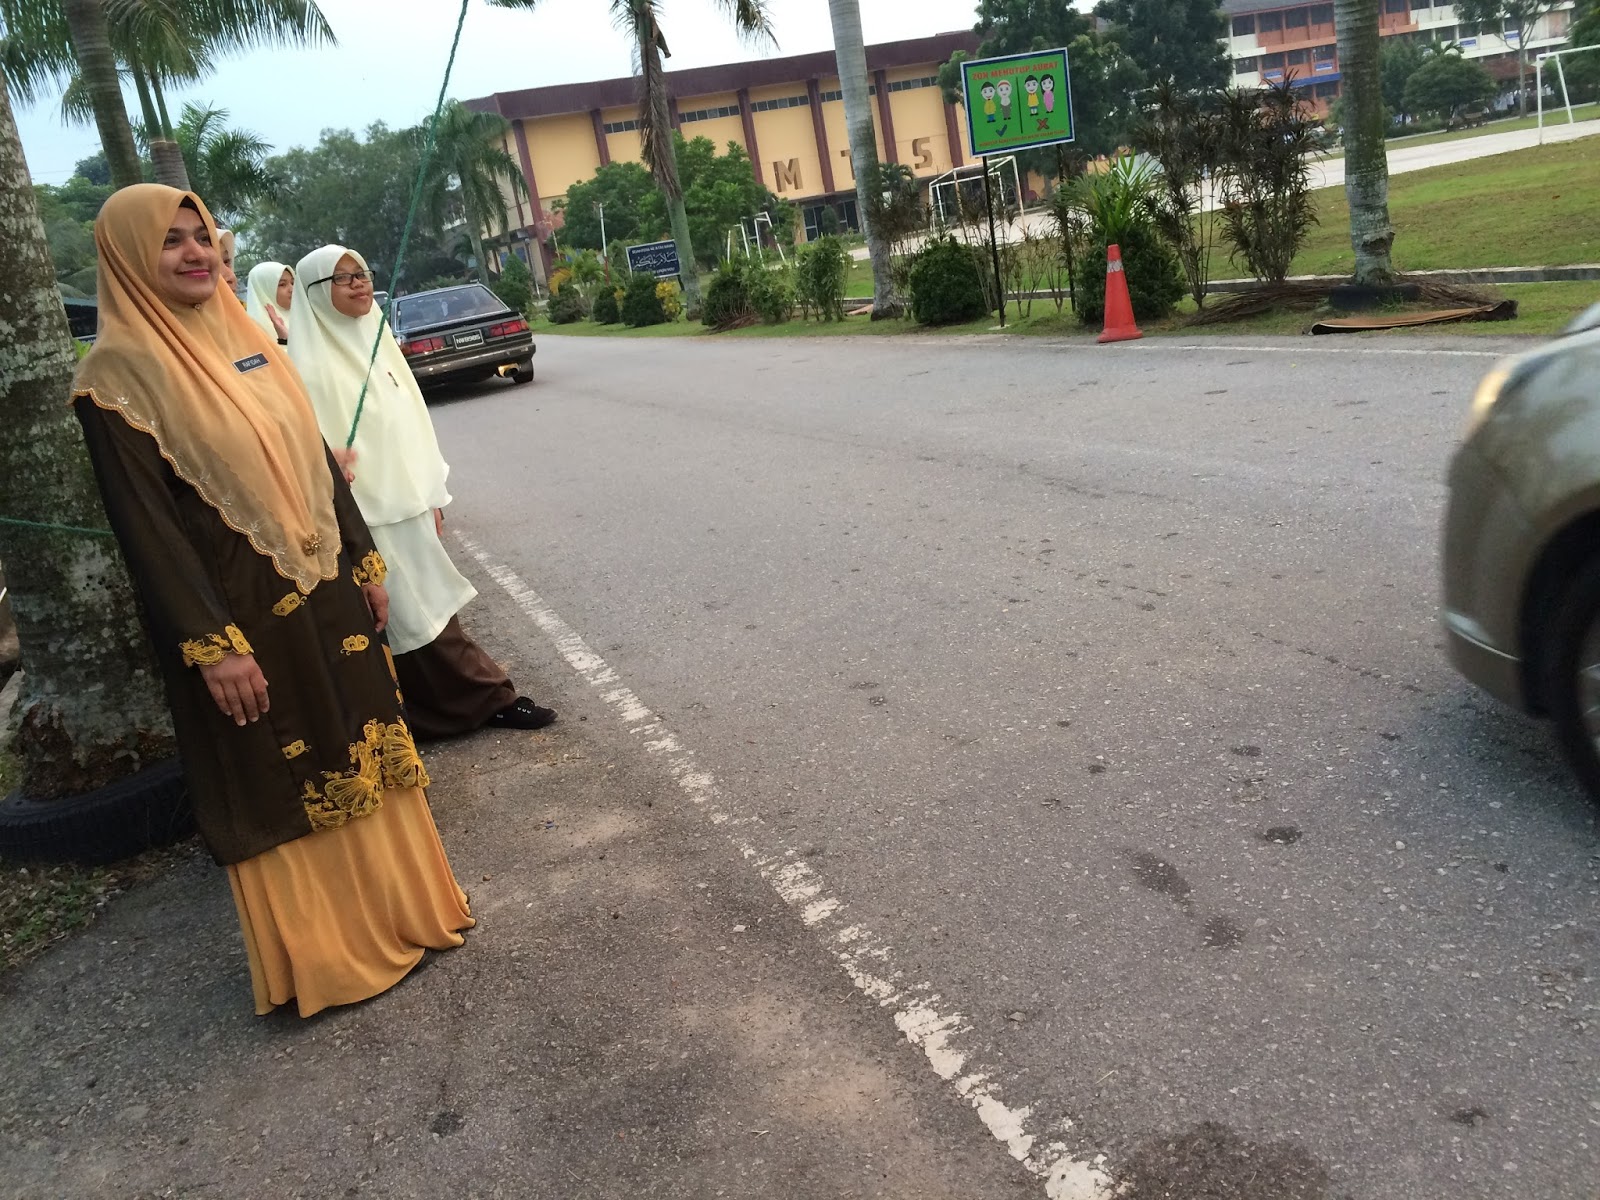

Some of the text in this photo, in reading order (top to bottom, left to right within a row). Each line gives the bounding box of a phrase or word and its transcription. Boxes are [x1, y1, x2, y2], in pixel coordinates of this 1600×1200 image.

[991, 66, 1030, 77] MENUTUP
[1033, 62, 1058, 71] AURAT
[772, 157, 803, 193] M
[911, 136, 933, 170] S
